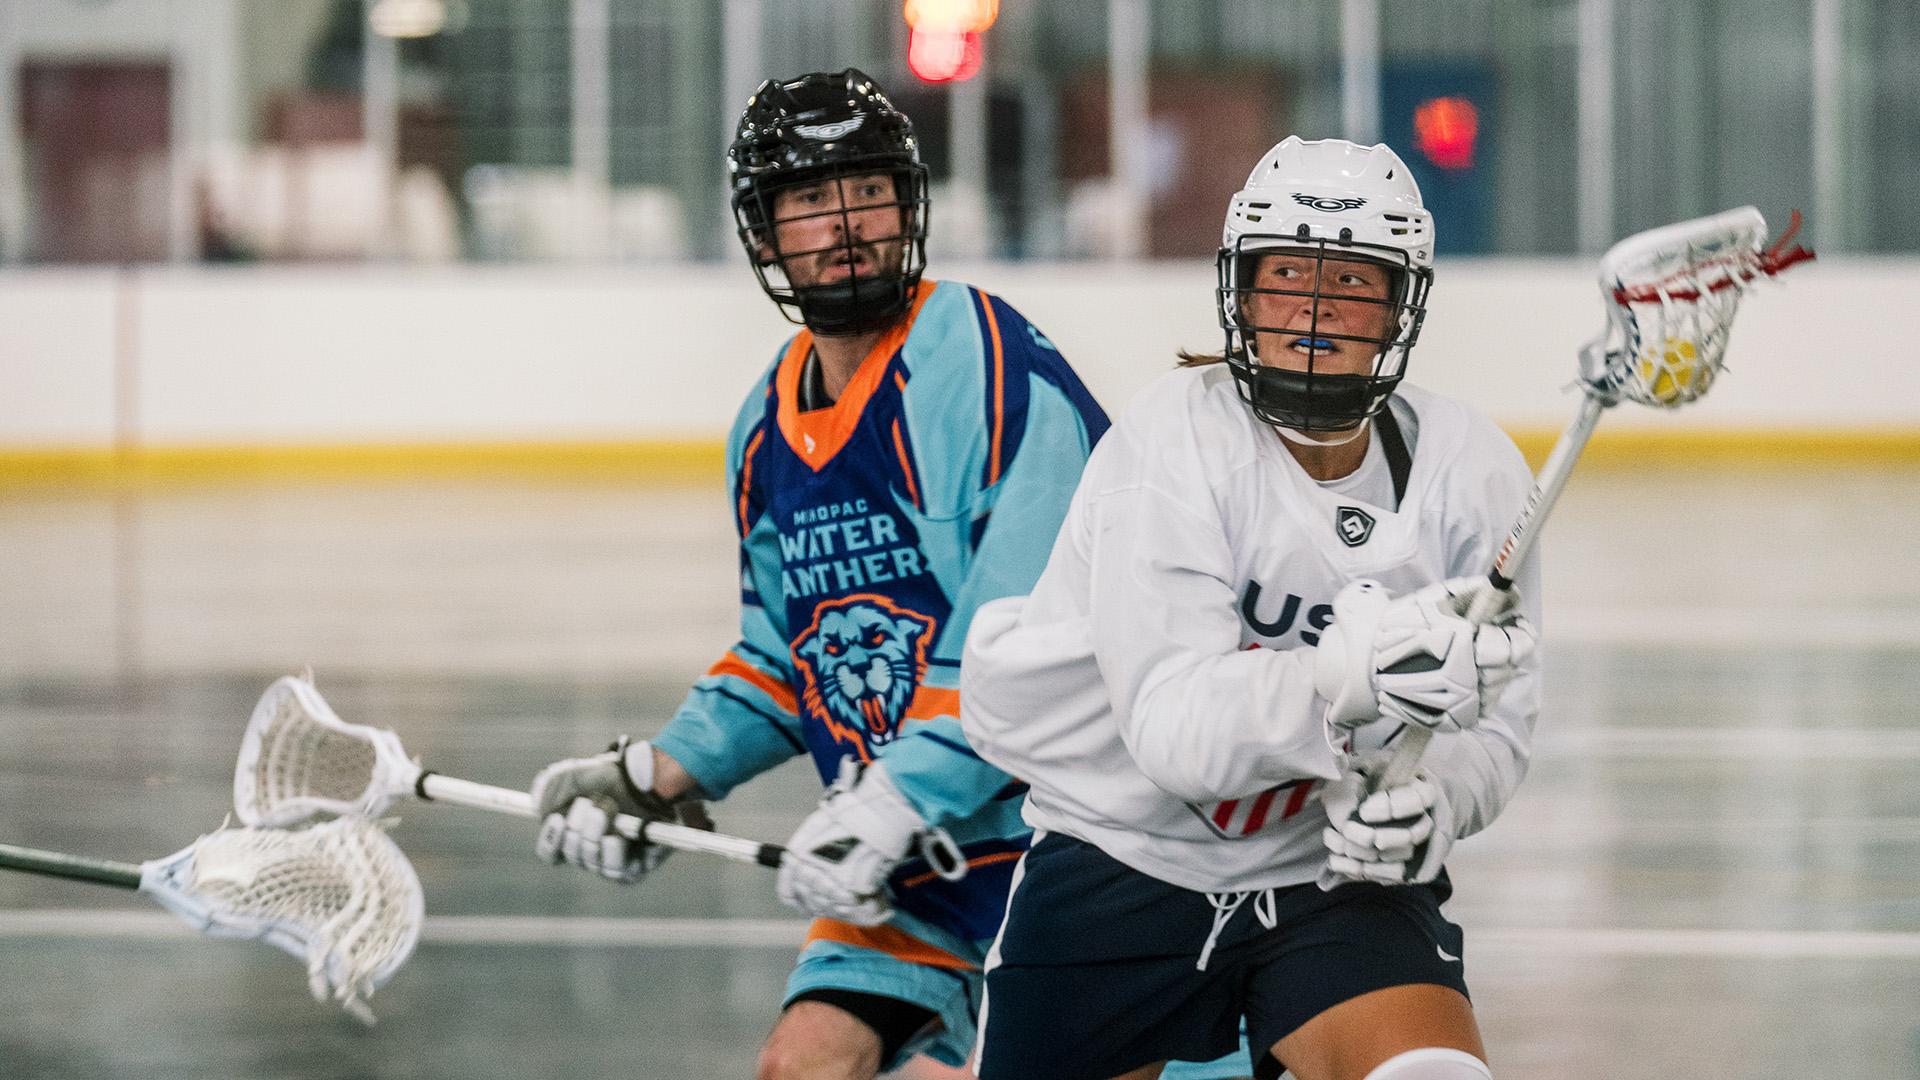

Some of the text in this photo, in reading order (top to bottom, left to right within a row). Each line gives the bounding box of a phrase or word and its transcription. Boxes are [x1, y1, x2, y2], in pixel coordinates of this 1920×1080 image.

[778, 513, 900, 563] WATER
[782, 547, 923, 601] ANTHER
[1241, 579, 1335, 648] US
